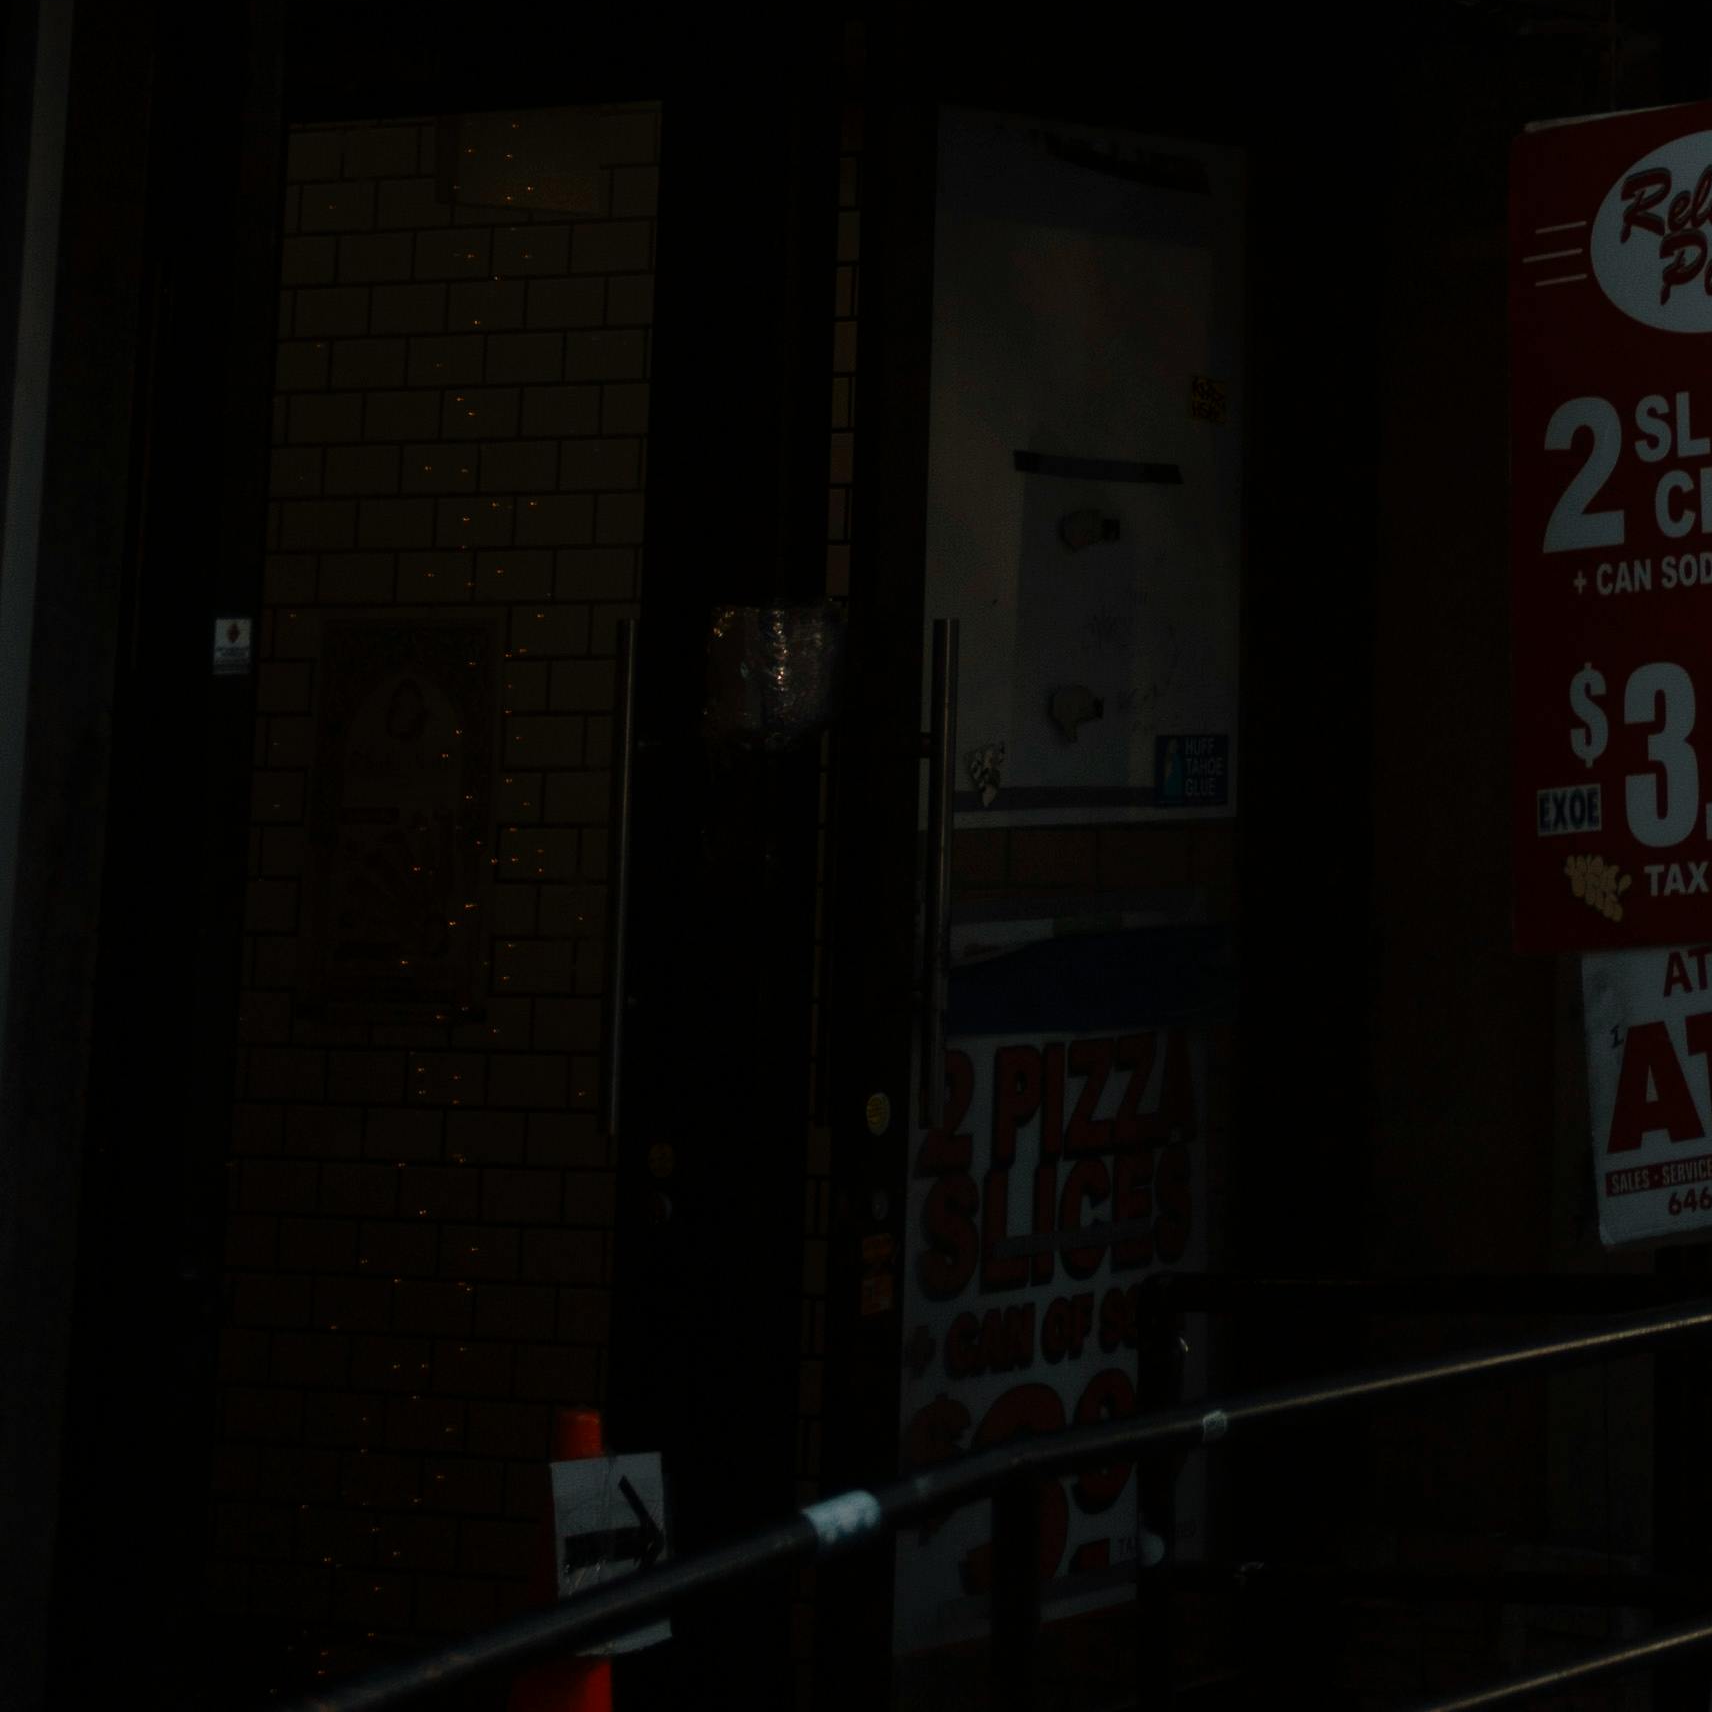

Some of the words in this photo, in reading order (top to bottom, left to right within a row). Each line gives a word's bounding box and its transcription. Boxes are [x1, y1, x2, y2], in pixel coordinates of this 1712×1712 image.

[1542, 395, 1626, 554] 2
[1596, 559, 1652, 596] CAN
[1644, 860, 1709, 898] TAX
[1610, 1171, 1650, 1195] SALES
[918, 1149, 1192, 1303] SLICES
[947, 1302, 1036, 1377] CAN
[1041, 1293, 1095, 1364] OF
